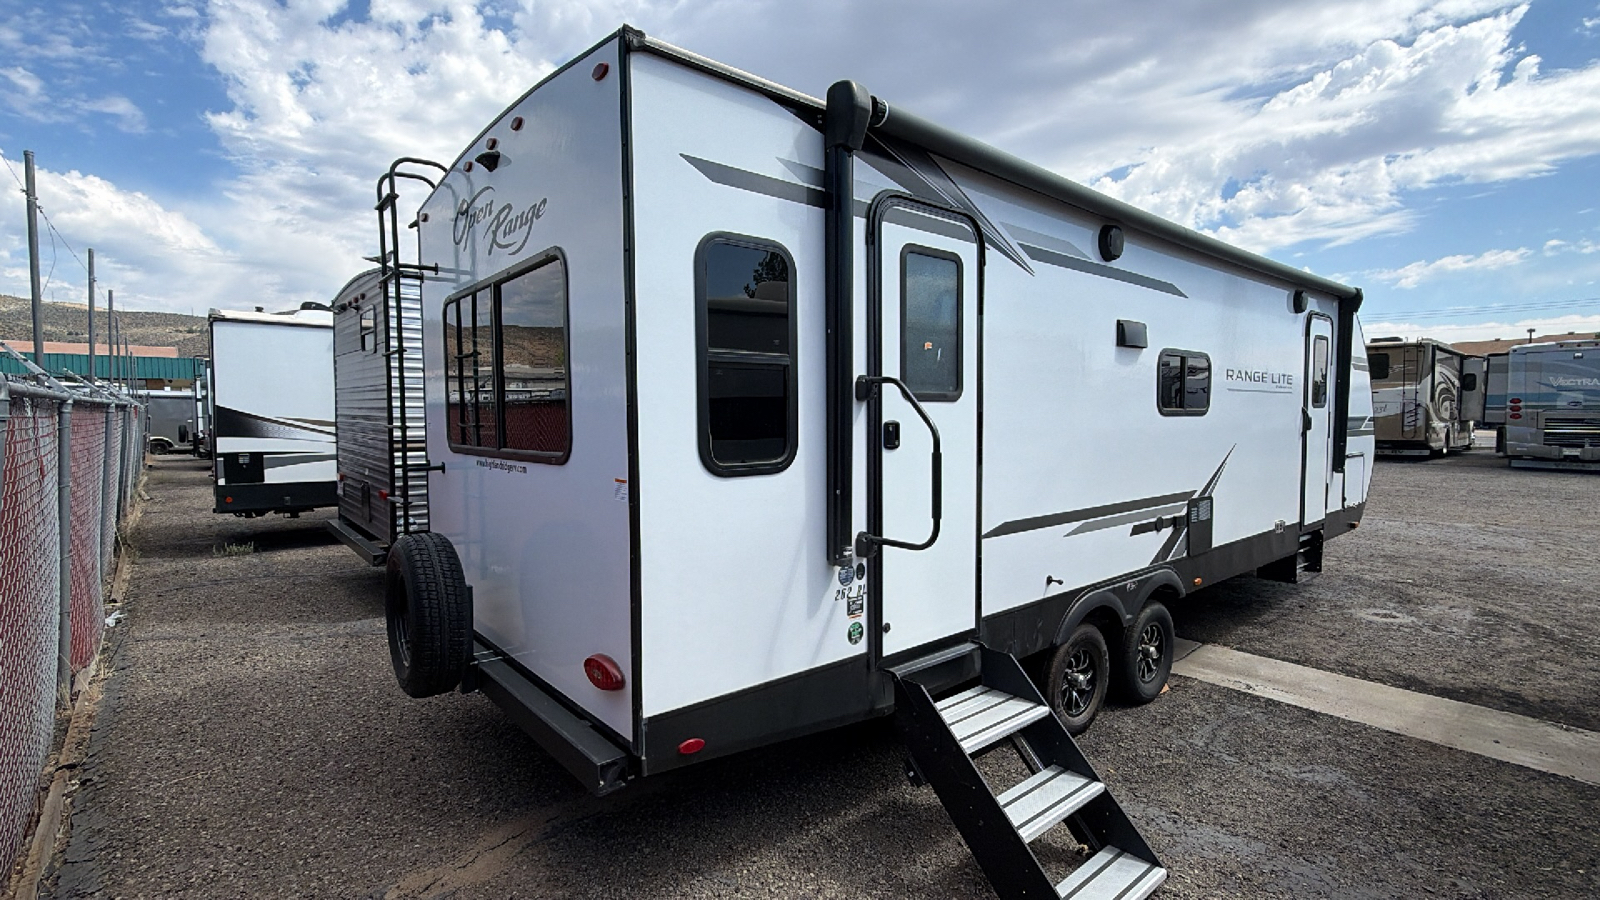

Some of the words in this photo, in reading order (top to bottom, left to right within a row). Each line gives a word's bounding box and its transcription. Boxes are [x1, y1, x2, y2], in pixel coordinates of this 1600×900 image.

[453, 186, 495, 252] Open
[483, 198, 548, 256] Range
[1226, 368, 1268, 384] RANGE
[1271, 373, 1293, 385] LITE
[835, 586, 852, 600] 262
